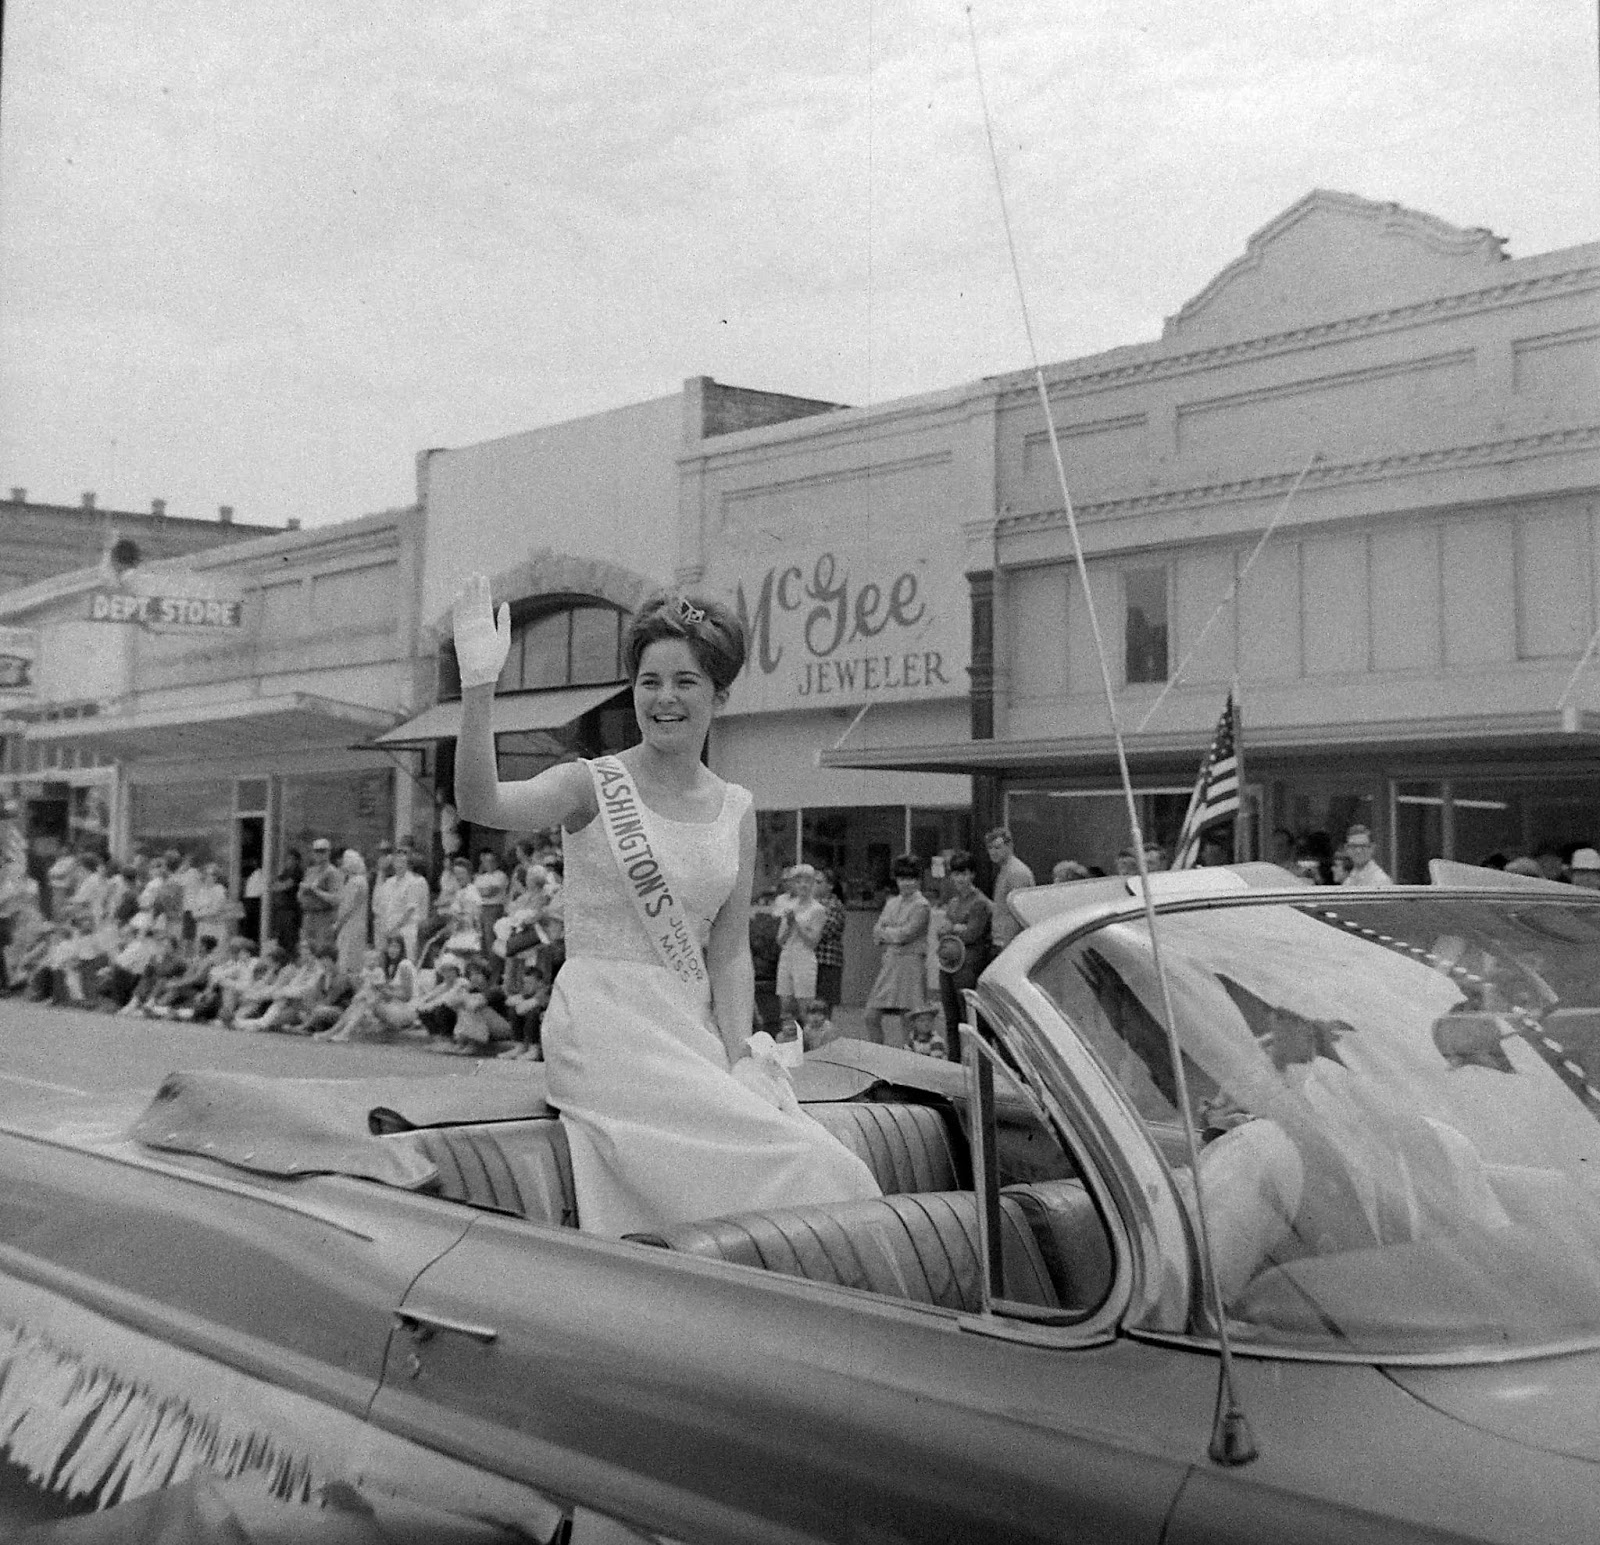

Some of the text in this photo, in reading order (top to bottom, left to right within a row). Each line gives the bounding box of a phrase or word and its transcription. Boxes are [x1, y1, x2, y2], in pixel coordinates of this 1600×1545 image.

[161, 598, 234, 626] STORE
[736, 553, 926, 679] McGee
[799, 652, 950, 696] JEWELER
[660, 934, 691, 983] MISS
[669, 917, 704, 980] JUNIOR
